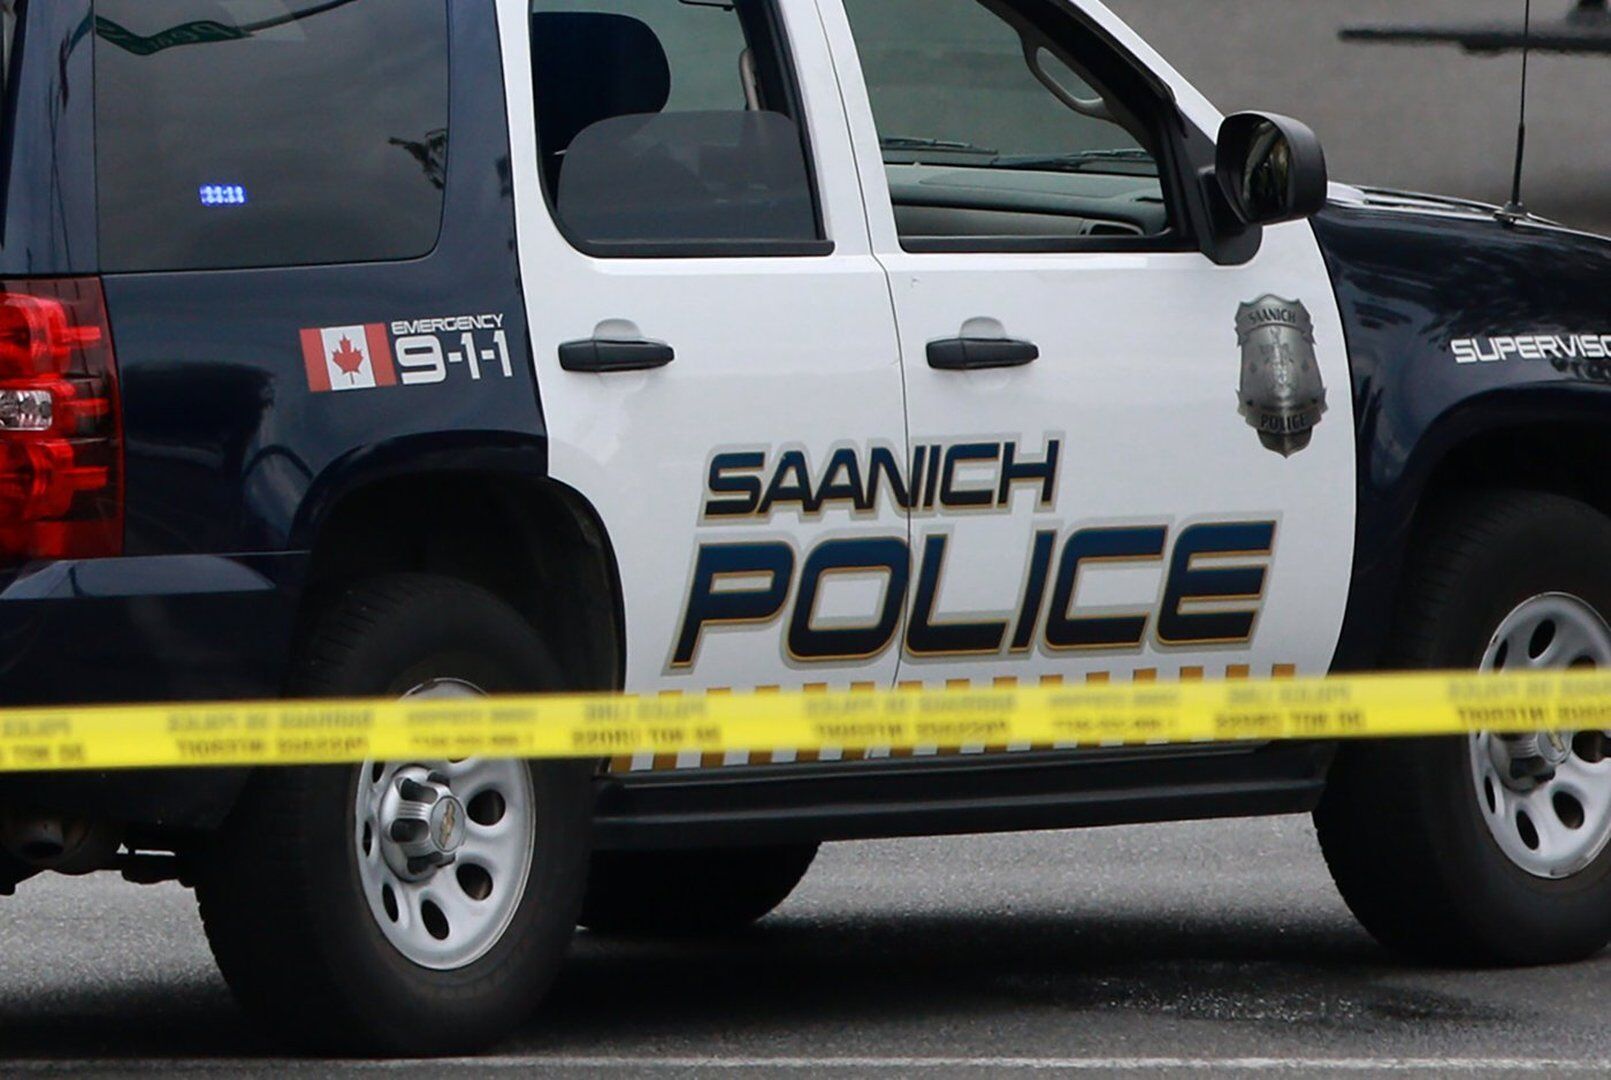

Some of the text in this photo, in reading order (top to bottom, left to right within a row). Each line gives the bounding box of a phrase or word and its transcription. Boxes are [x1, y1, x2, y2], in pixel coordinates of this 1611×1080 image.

[391, 313, 504, 335] EMERGENCY
[1249, 308, 1297, 325] SAANICH
[395, 329, 513, 386] 9-1-1
[1260, 413, 1306, 431] POLICE
[703, 438, 1061, 519] SAANICH
[668, 518, 1277, 669] POLICE
